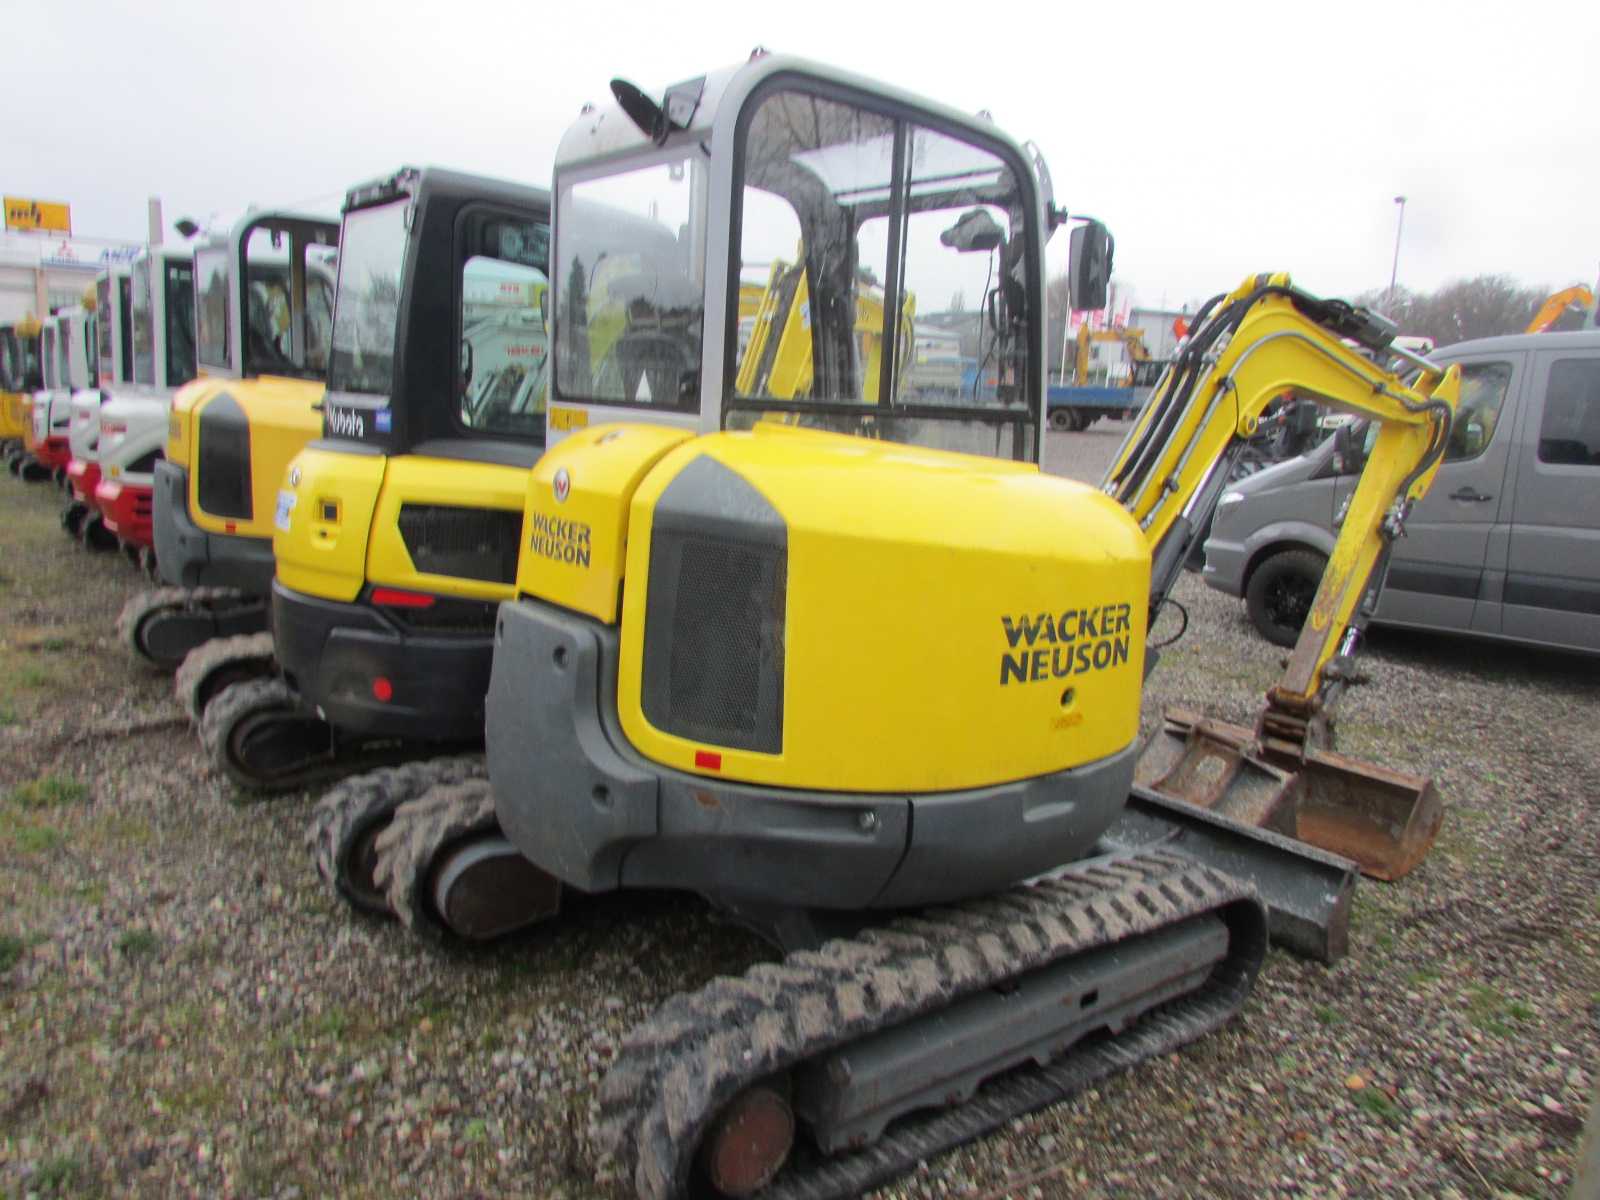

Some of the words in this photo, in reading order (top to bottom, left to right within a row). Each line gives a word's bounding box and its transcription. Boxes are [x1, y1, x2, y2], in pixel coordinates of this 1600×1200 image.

[329, 406, 364, 438] Kubota
[533, 511, 591, 544] WACKER
[531, 533, 591, 568] NEUSON
[1001, 602, 1130, 648] WACKER
[1000, 635, 1130, 685] NEUSON
